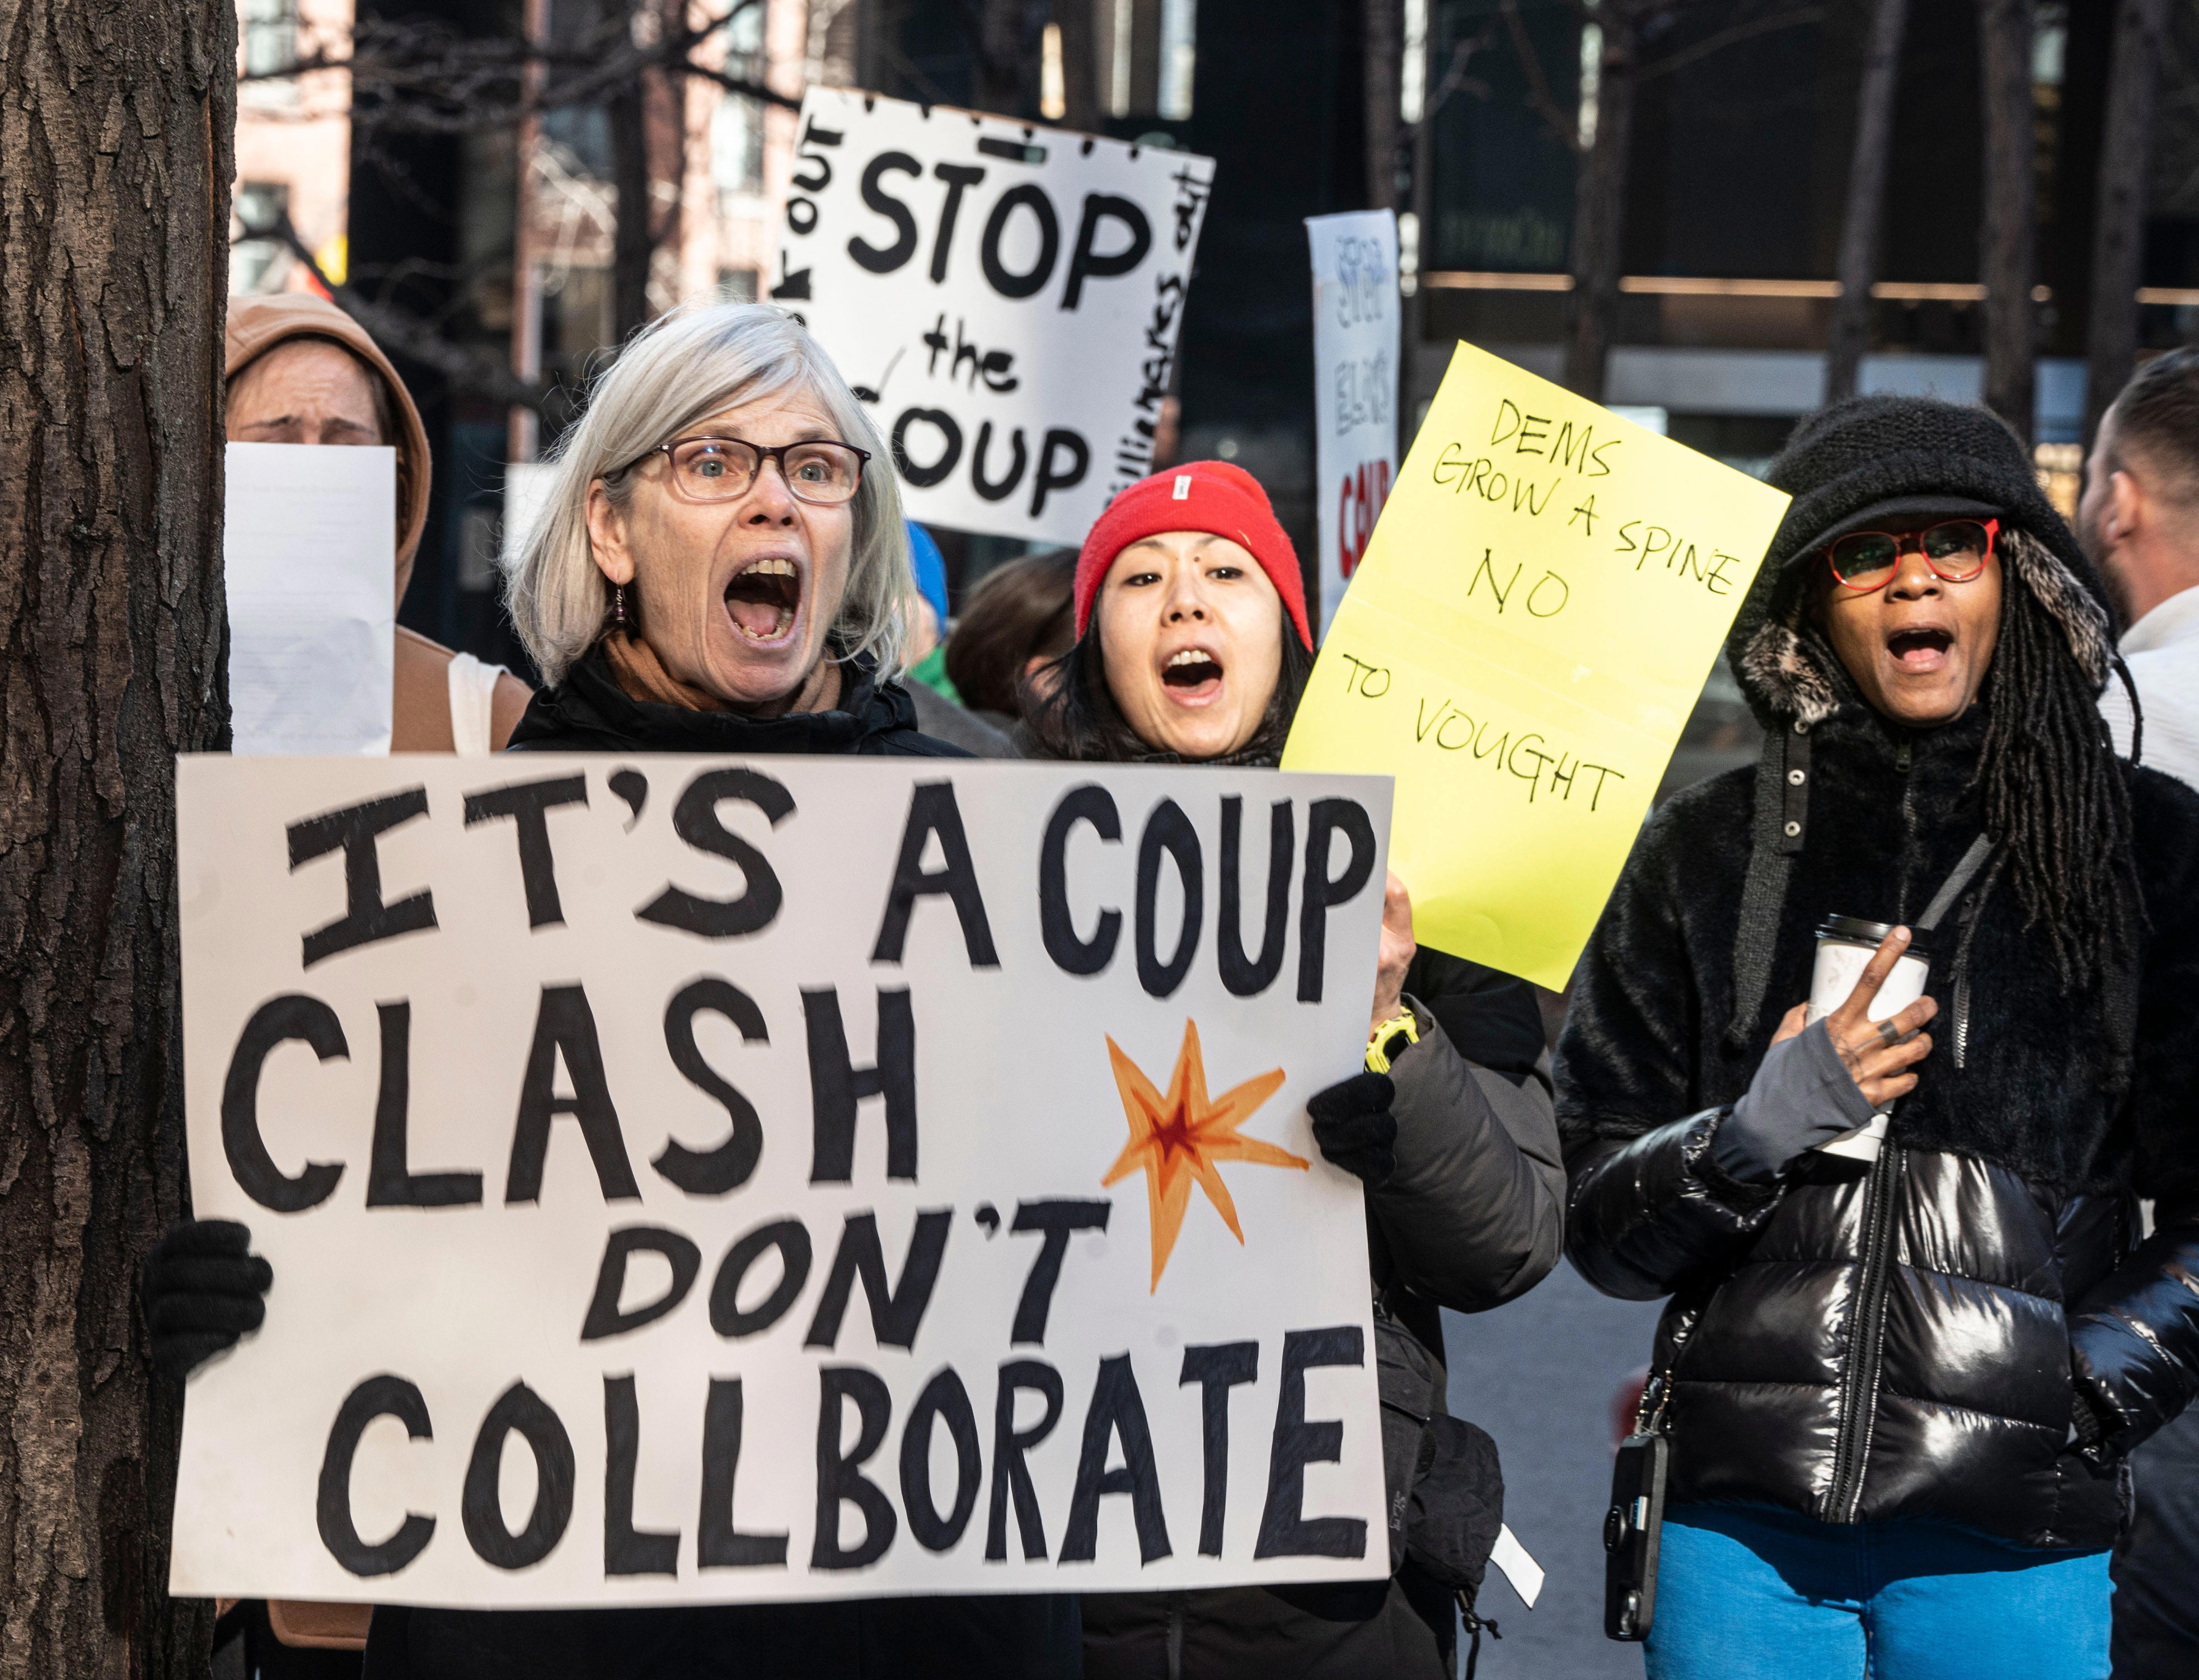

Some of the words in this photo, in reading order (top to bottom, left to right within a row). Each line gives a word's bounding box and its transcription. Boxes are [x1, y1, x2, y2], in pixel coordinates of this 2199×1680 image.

[786, 114, 844, 236] OUT
[847, 151, 1154, 312] STOP
[1171, 163, 1211, 251] out
[923, 313, 1019, 393] the
[851, 386, 1091, 519] OUP
[1491, 398, 1623, 477] DEMS
[1433, 442, 1561, 516] GROW
[1568, 494, 1600, 536] A
[1615, 520, 1742, 595] SPINE
[1467, 547, 1569, 618] NO
[1343, 653, 1390, 698] TO
[1415, 698, 1625, 813] VOUGHT
[285, 767, 798, 971] IT'S
[870, 778, 1002, 970] A
[1038, 782, 1377, 1005] COUP
[219, 975, 919, 1215] CLASH
[579, 1196, 1113, 1353] DON'T
[316, 1325, 1369, 1579] COLLBORATE
